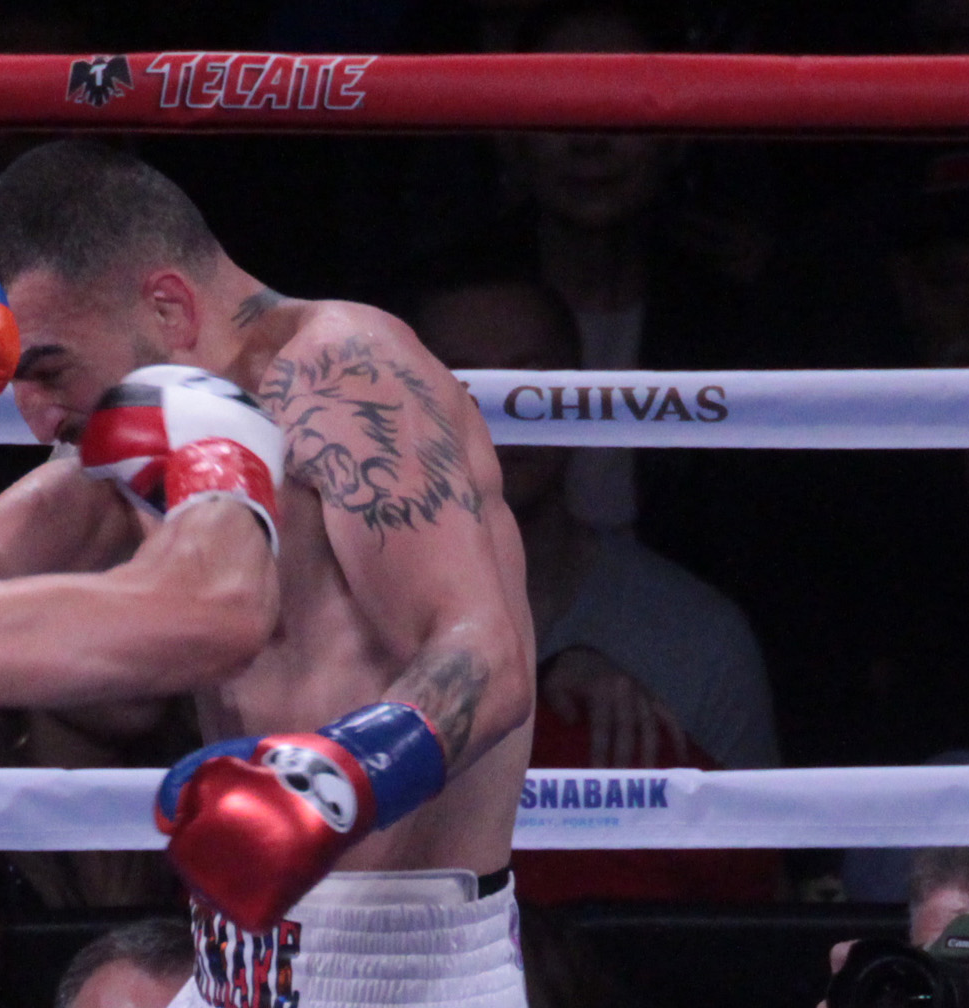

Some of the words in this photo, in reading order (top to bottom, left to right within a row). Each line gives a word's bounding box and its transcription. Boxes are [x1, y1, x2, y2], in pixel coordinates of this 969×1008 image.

[146, 51, 379, 110] TECATE
[503, 385, 729, 423] CHIVAS
[519, 777, 669, 810] SNABANK
